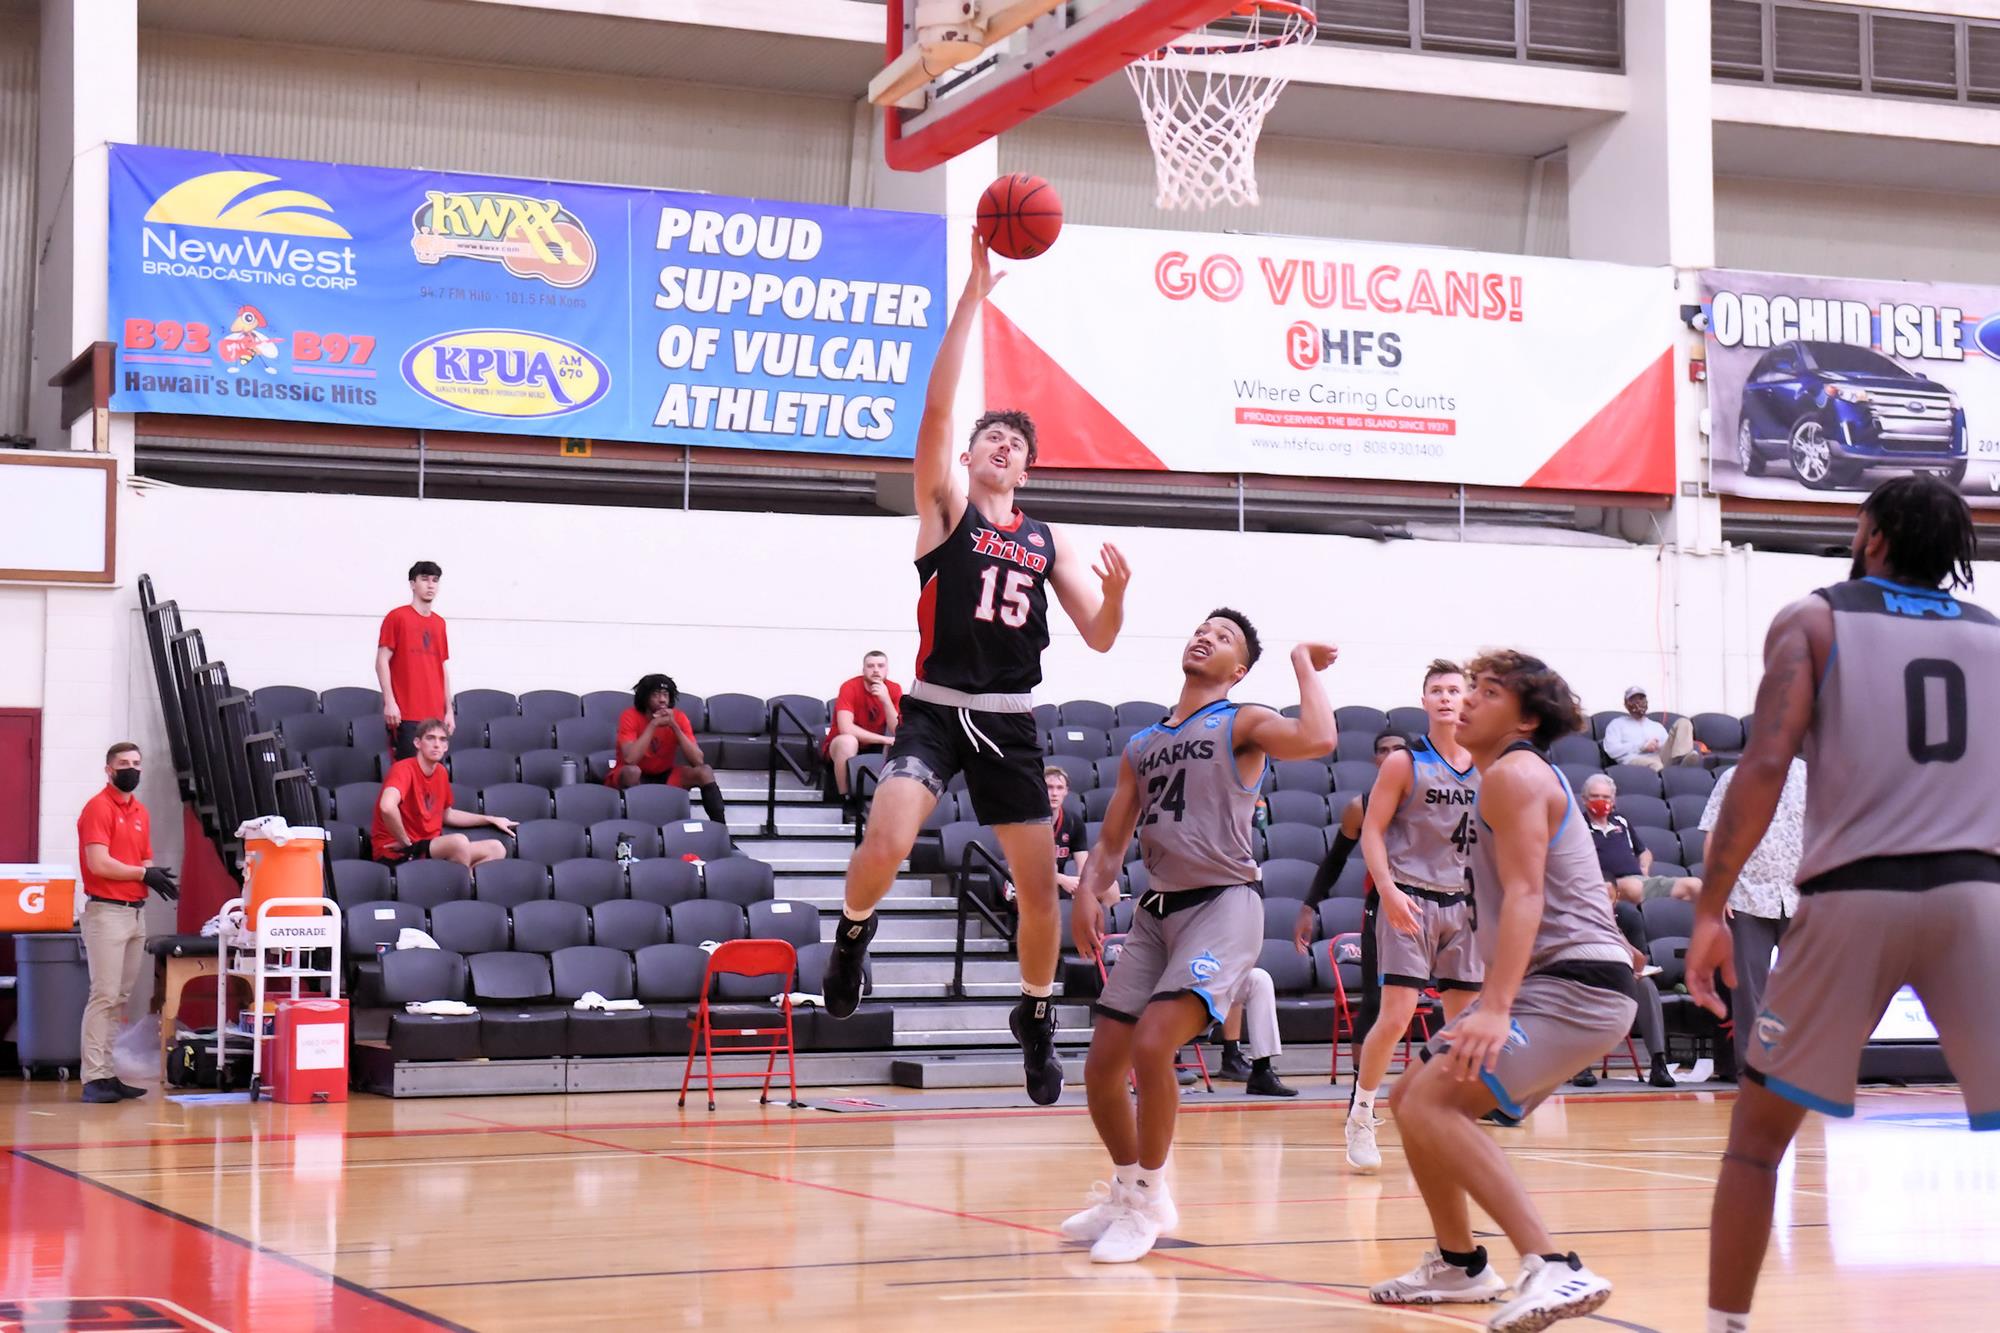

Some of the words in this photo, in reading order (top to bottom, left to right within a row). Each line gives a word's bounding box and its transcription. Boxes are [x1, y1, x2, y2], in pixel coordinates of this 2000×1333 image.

[143, 227, 356, 275] NewWest
[656, 207, 823, 261] PROUD
[143, 261, 296, 286] BROADCASTING
[301, 274, 358, 290] CORP
[655, 265, 932, 328] SUPPORTER
[1155, 251, 1244, 302] GO
[1258, 257, 1523, 322] VULCANS!
[124, 318, 211, 353] B93
[292, 330, 376, 365] B97
[1711, 291, 1872, 348] ORCHID
[1879, 303, 1964, 361] ISLE
[559, 355, 582, 366] AM
[657, 324, 721, 371] OF
[733, 330, 912, 384] VULCAN
[1321, 328, 1402, 368] HFS
[125, 371, 229, 396] Hawaii's
[235, 377, 325, 402] Classic
[332, 384, 377, 406] Hits
[433, 346, 576, 405] KPUA
[559, 368, 583, 379] 670
[1233, 379, 1300, 402] Where
[1309, 383, 1377, 411] Caring
[1385, 388, 1456, 410] Counts
[653, 383, 896, 441] ATHLETICS
[1243, 411, 1283, 423] PROUDLY
[1284, 414, 1324, 425] SERVING
[1327, 416, 1345, 426] THE
[1346, 417, 1363, 427] BIG
[1364, 418, 1398, 429] ISLAND
[1398, 420, 1425, 431] SINCE
[970, 527, 1047, 573] Hilo
[974, 565, 1034, 628] 15
[1904, 658, 1967, 765] 0
[1138, 768, 1186, 827] 24
[1425, 789, 1475, 805] SHAR
[19, 886, 46, 914] G
[270, 927, 327, 937] GATORADE
